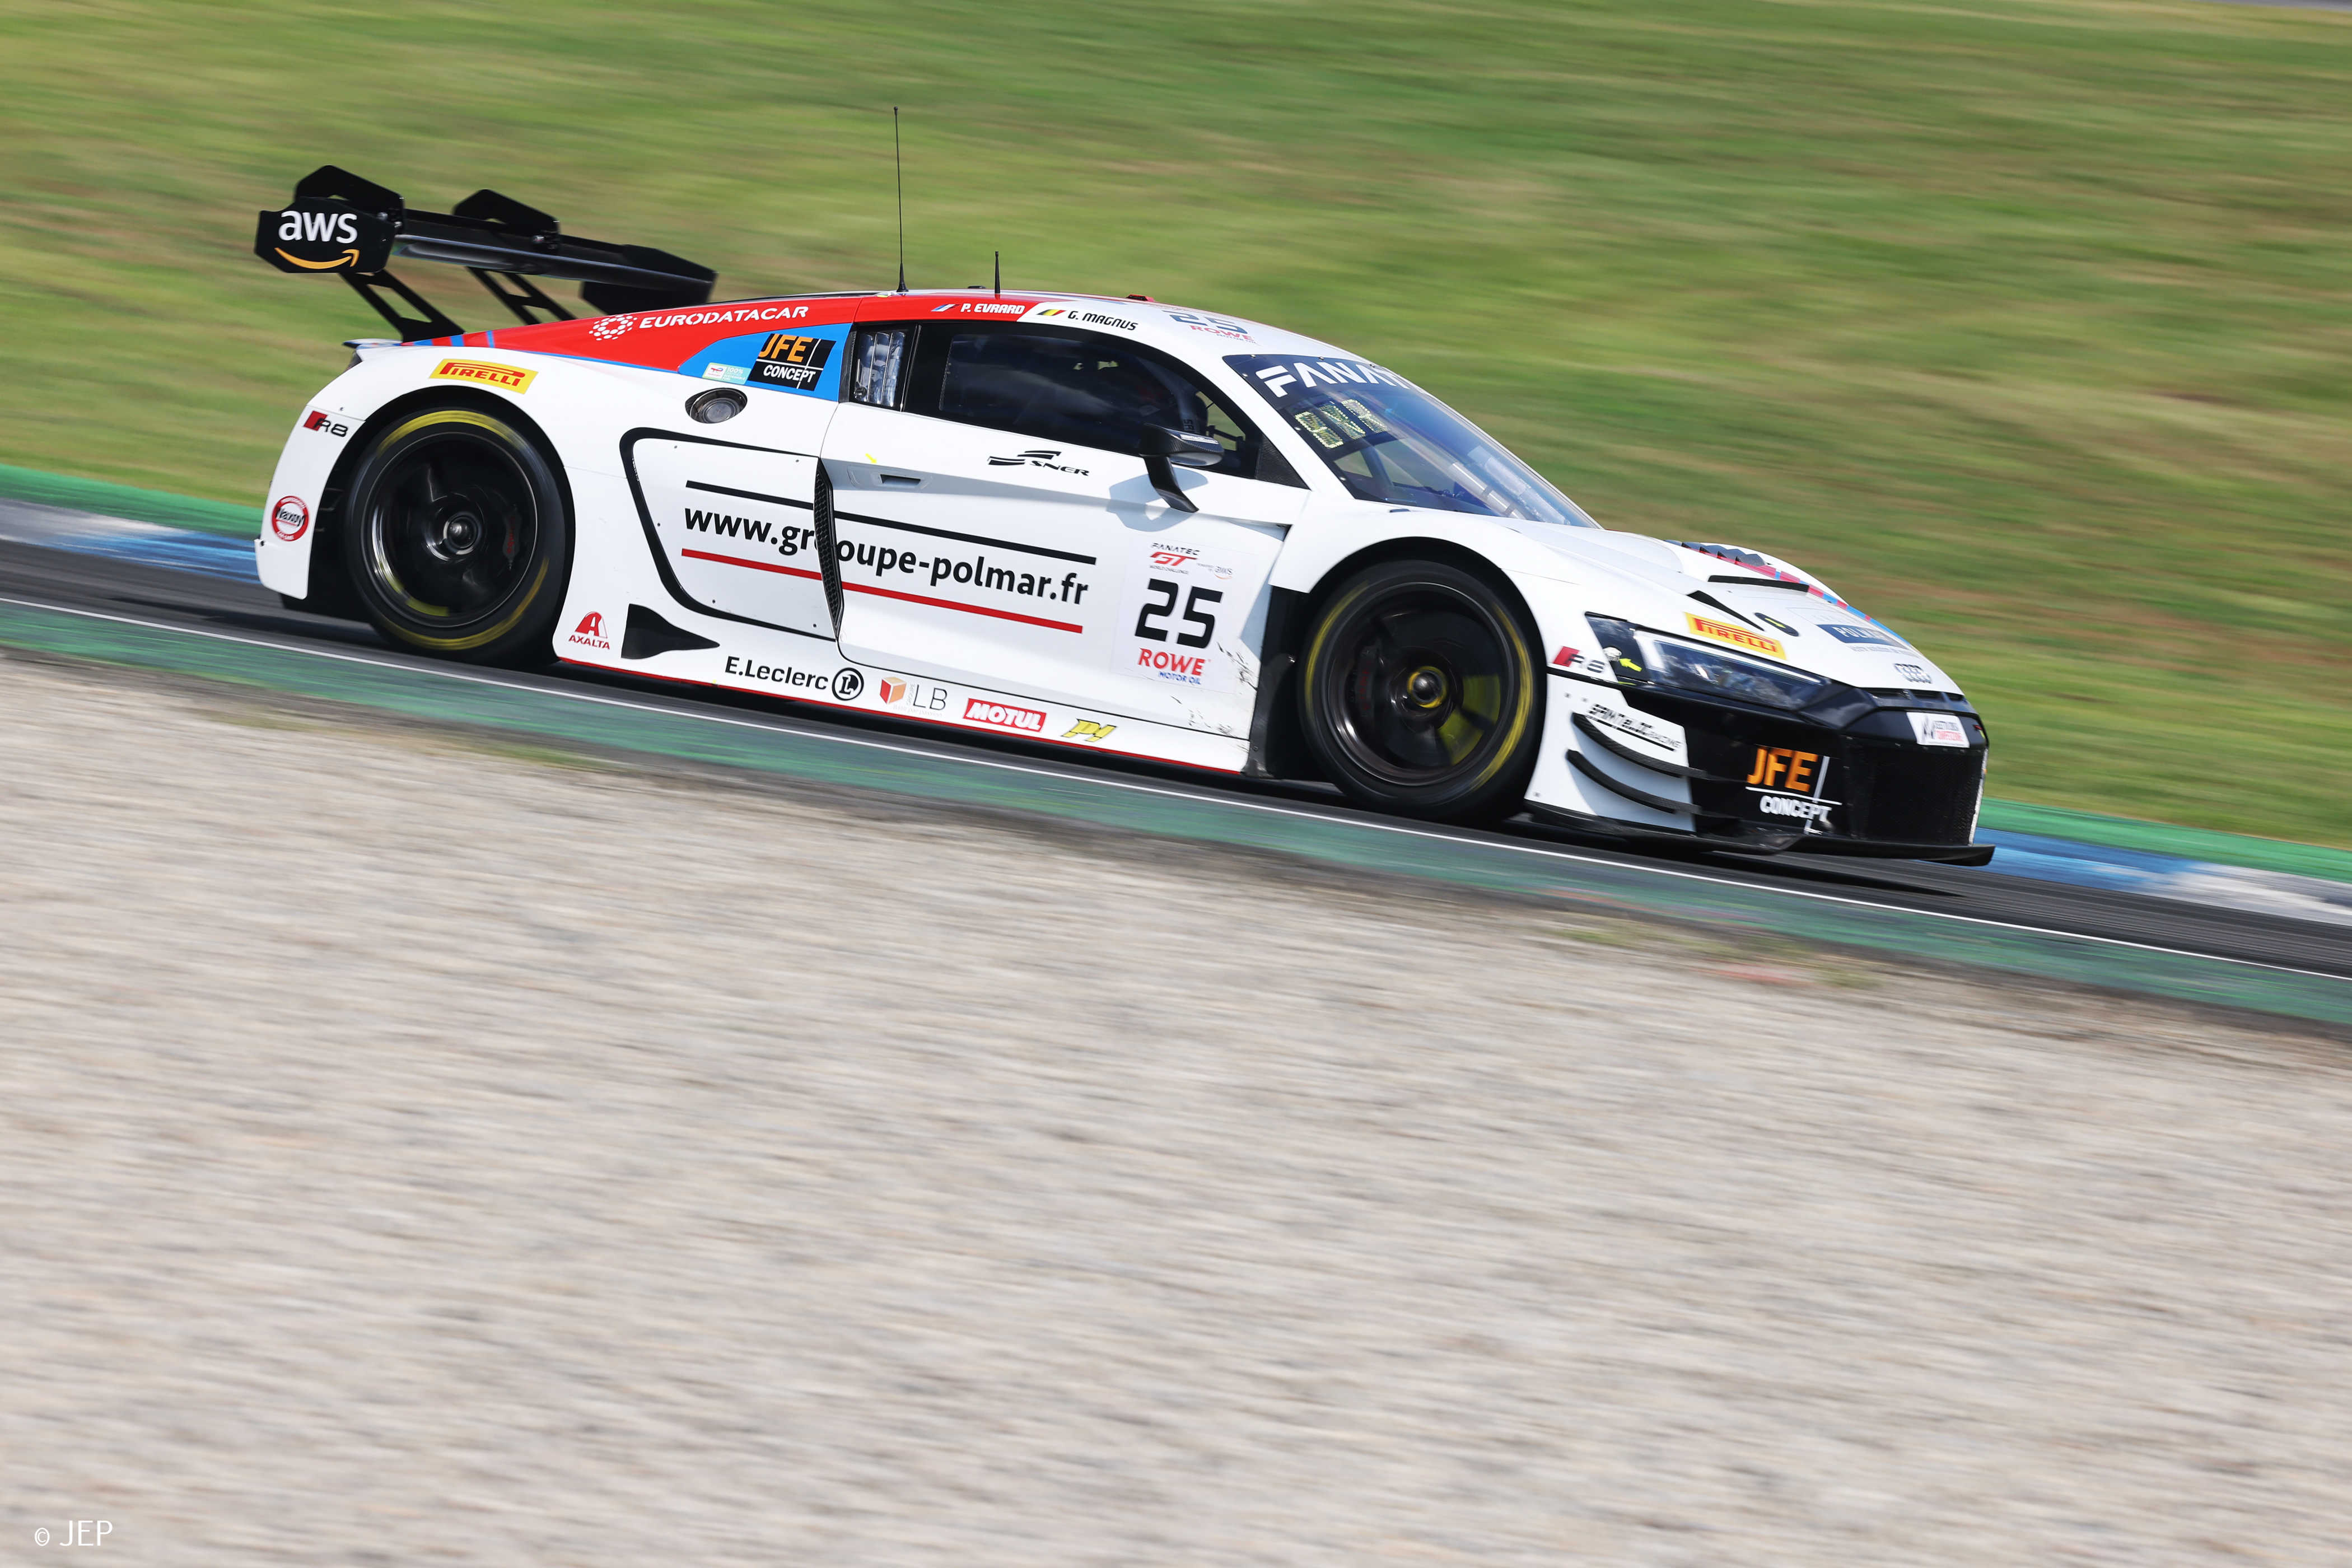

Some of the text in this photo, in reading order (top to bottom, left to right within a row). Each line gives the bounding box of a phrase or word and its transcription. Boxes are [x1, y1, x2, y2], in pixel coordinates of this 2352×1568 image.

[278, 211, 358, 244] aws
[639, 306, 809, 329] EURODATACAR
[960, 303, 1026, 314] P. EVRARD
[1067, 311, 1138, 330] G. MAGNUS
[1161, 310, 1248, 334] 25
[1189, 325, 1255, 341] ROWE
[758, 334, 814, 362] JFE
[439, 362, 526, 387] PIRELLI
[763, 364, 816, 383] CONCEPT
[1256, 361, 1411, 398] FANAT
[314, 418, 348, 437] R8
[1150, 552, 1198, 566] GT
[1151, 543, 1200, 556] FANATEC
[1135, 578, 1223, 649] 25
[568, 634, 610, 650] AXALTA
[1692, 617, 1778, 652] PIRELLI
[725, 656, 829, 690] E.Leclerc
[1138, 647, 1206, 676] ROWE
[1159, 671, 1201, 685] MOTOR OIL
[913, 684, 948, 711] LB
[965, 702, 1042, 730] MOTUL
[1747, 748, 1819, 793] JFE
[1760, 795, 1833, 822] CONCEPT
